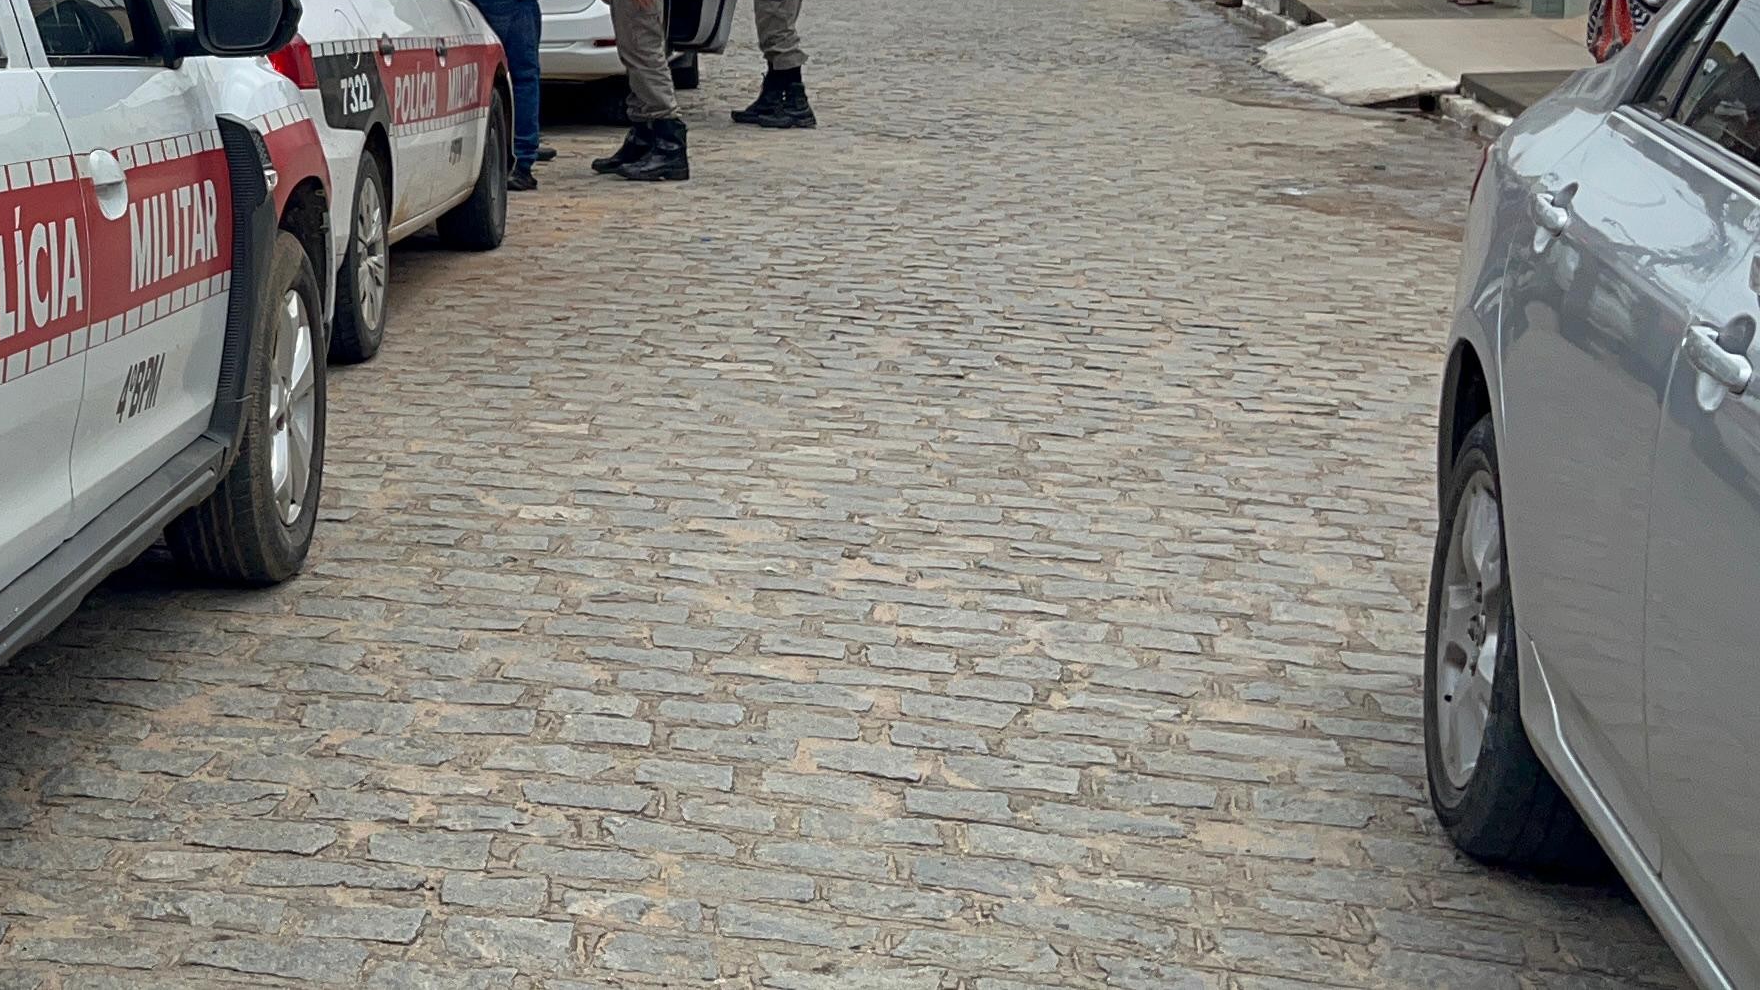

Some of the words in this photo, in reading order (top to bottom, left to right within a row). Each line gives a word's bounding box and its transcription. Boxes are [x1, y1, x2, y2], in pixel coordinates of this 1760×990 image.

[340, 72, 375, 115] 7322
[394, 61, 438, 124] POLÍCIA
[447, 62, 479, 112] MILITAR
[129, 179, 219, 292] MILITAR
